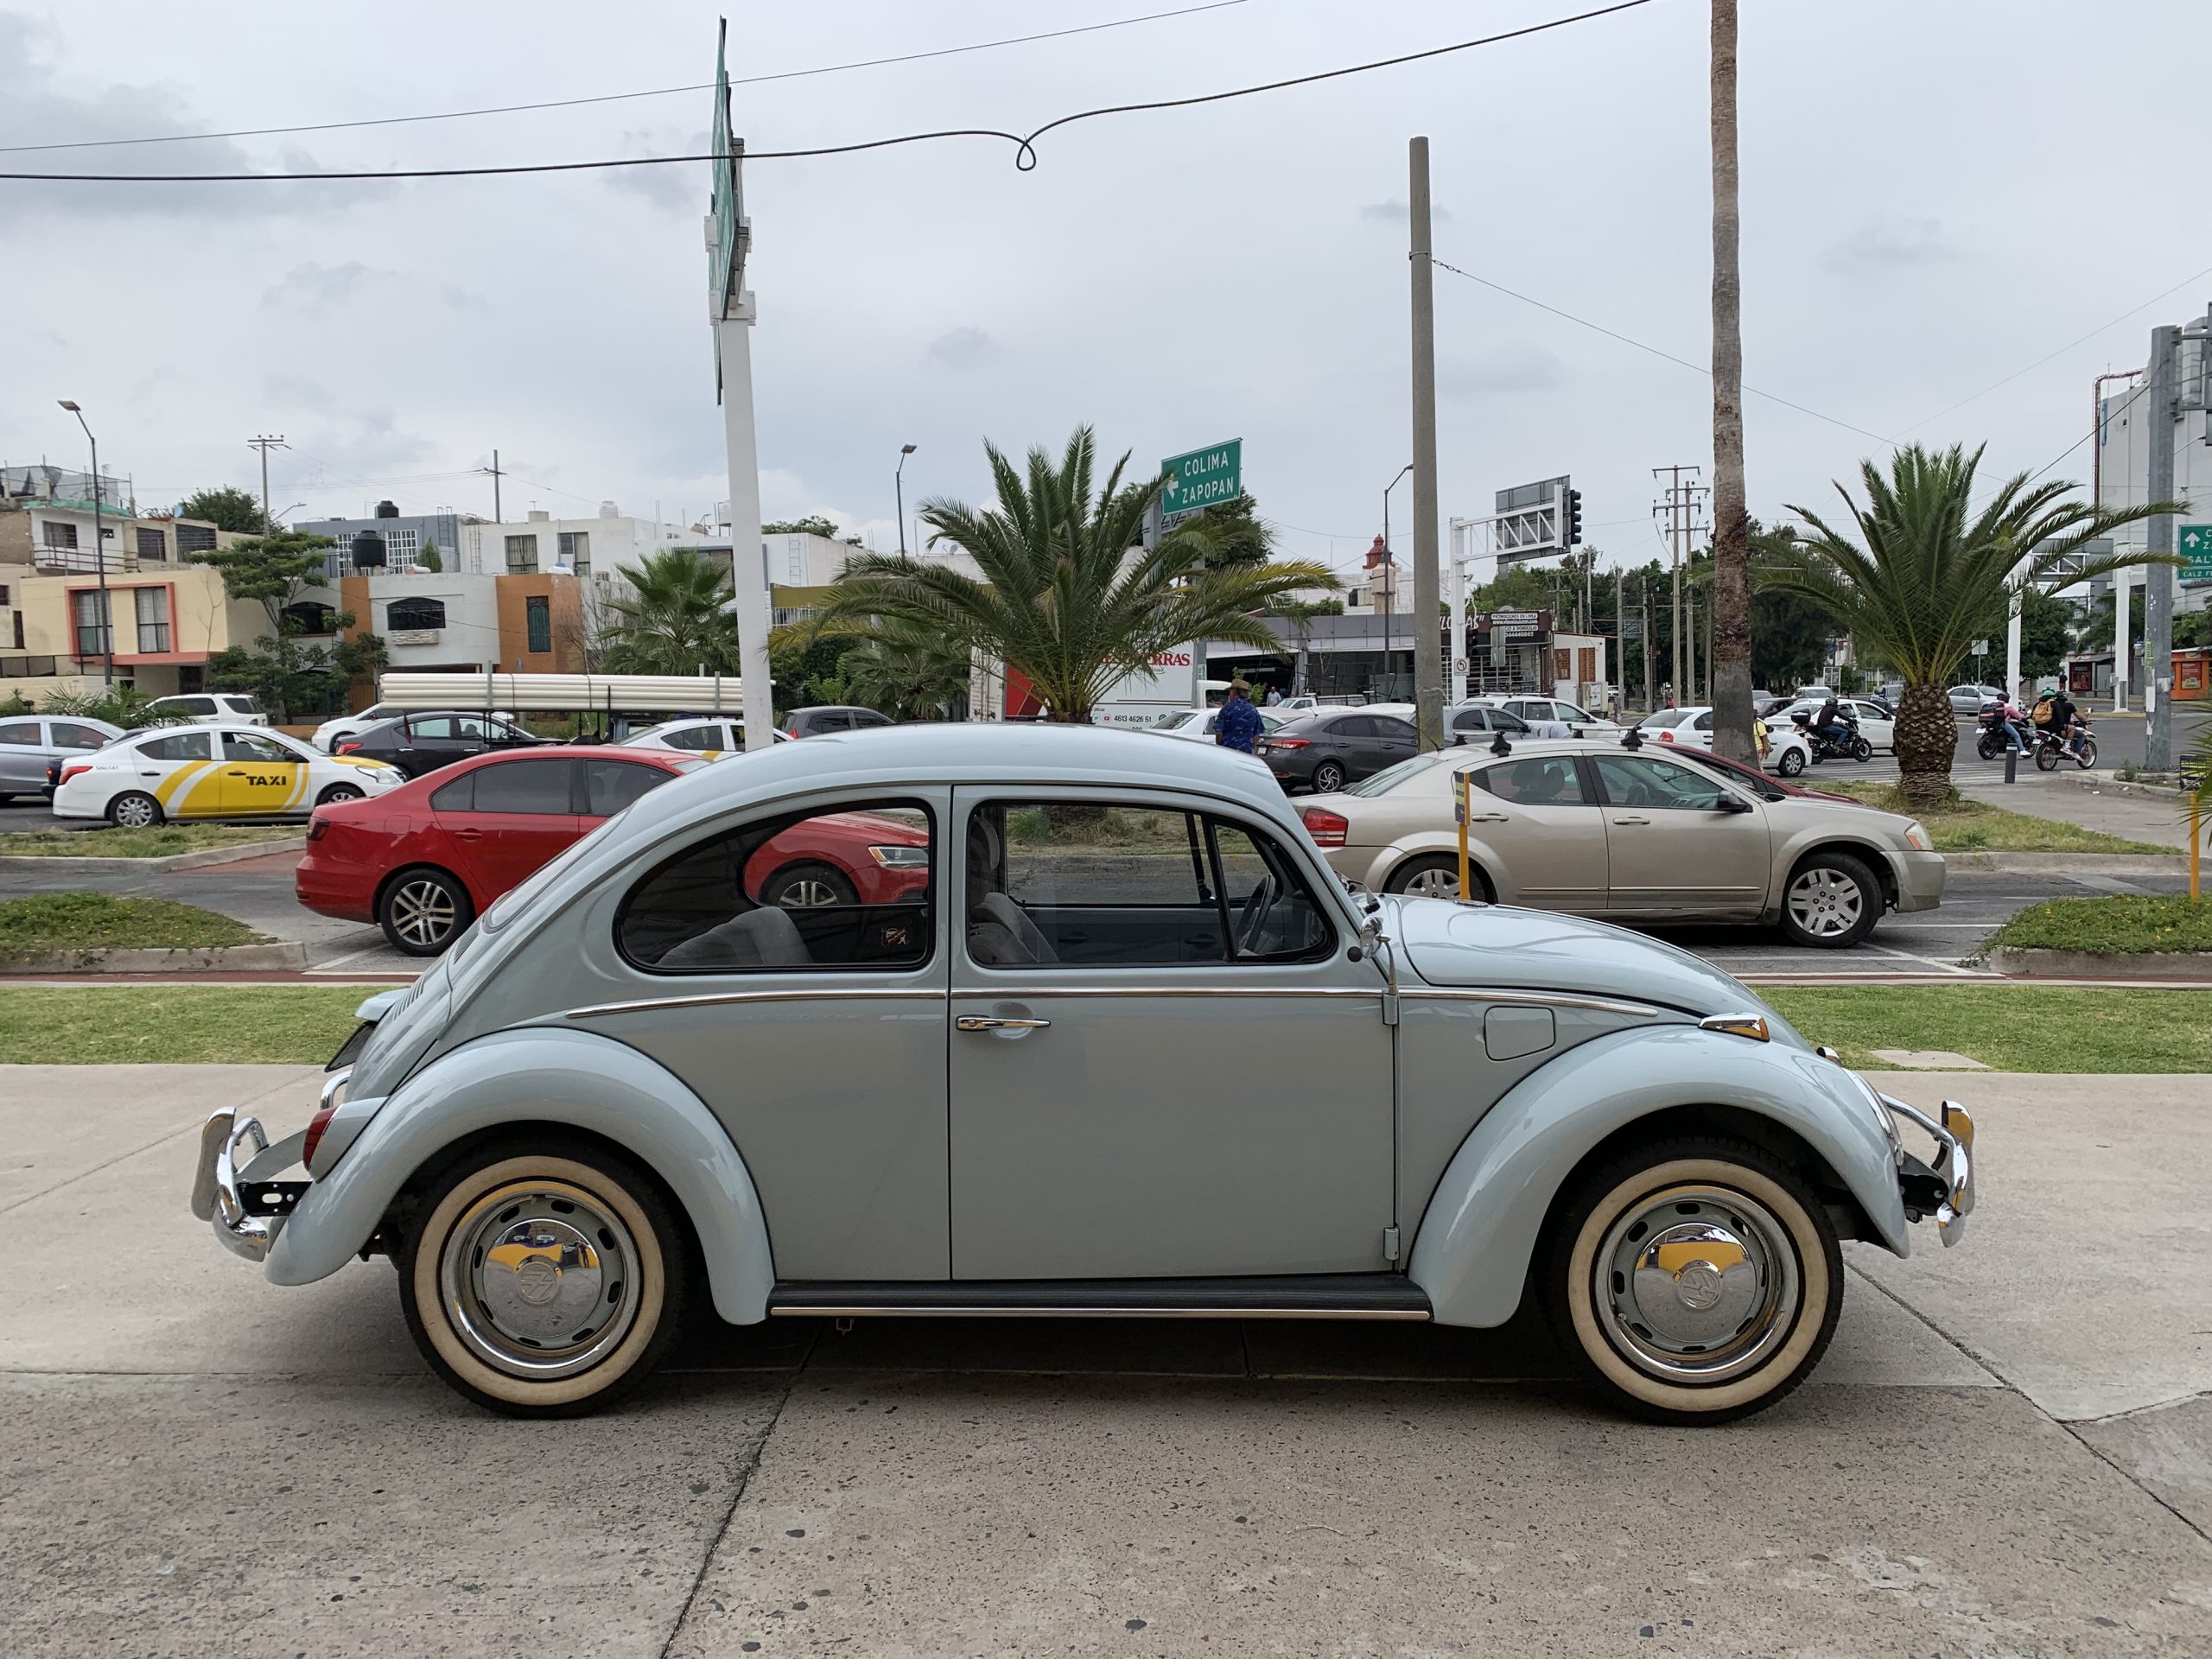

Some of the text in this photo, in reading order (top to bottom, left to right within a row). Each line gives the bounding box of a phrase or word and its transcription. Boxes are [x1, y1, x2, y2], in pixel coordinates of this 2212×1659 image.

[1185, 450, 1229, 477] COLIMA
[1182, 476, 1234, 505] ZAPOPAN
[246, 776, 287, 785] TAXI
